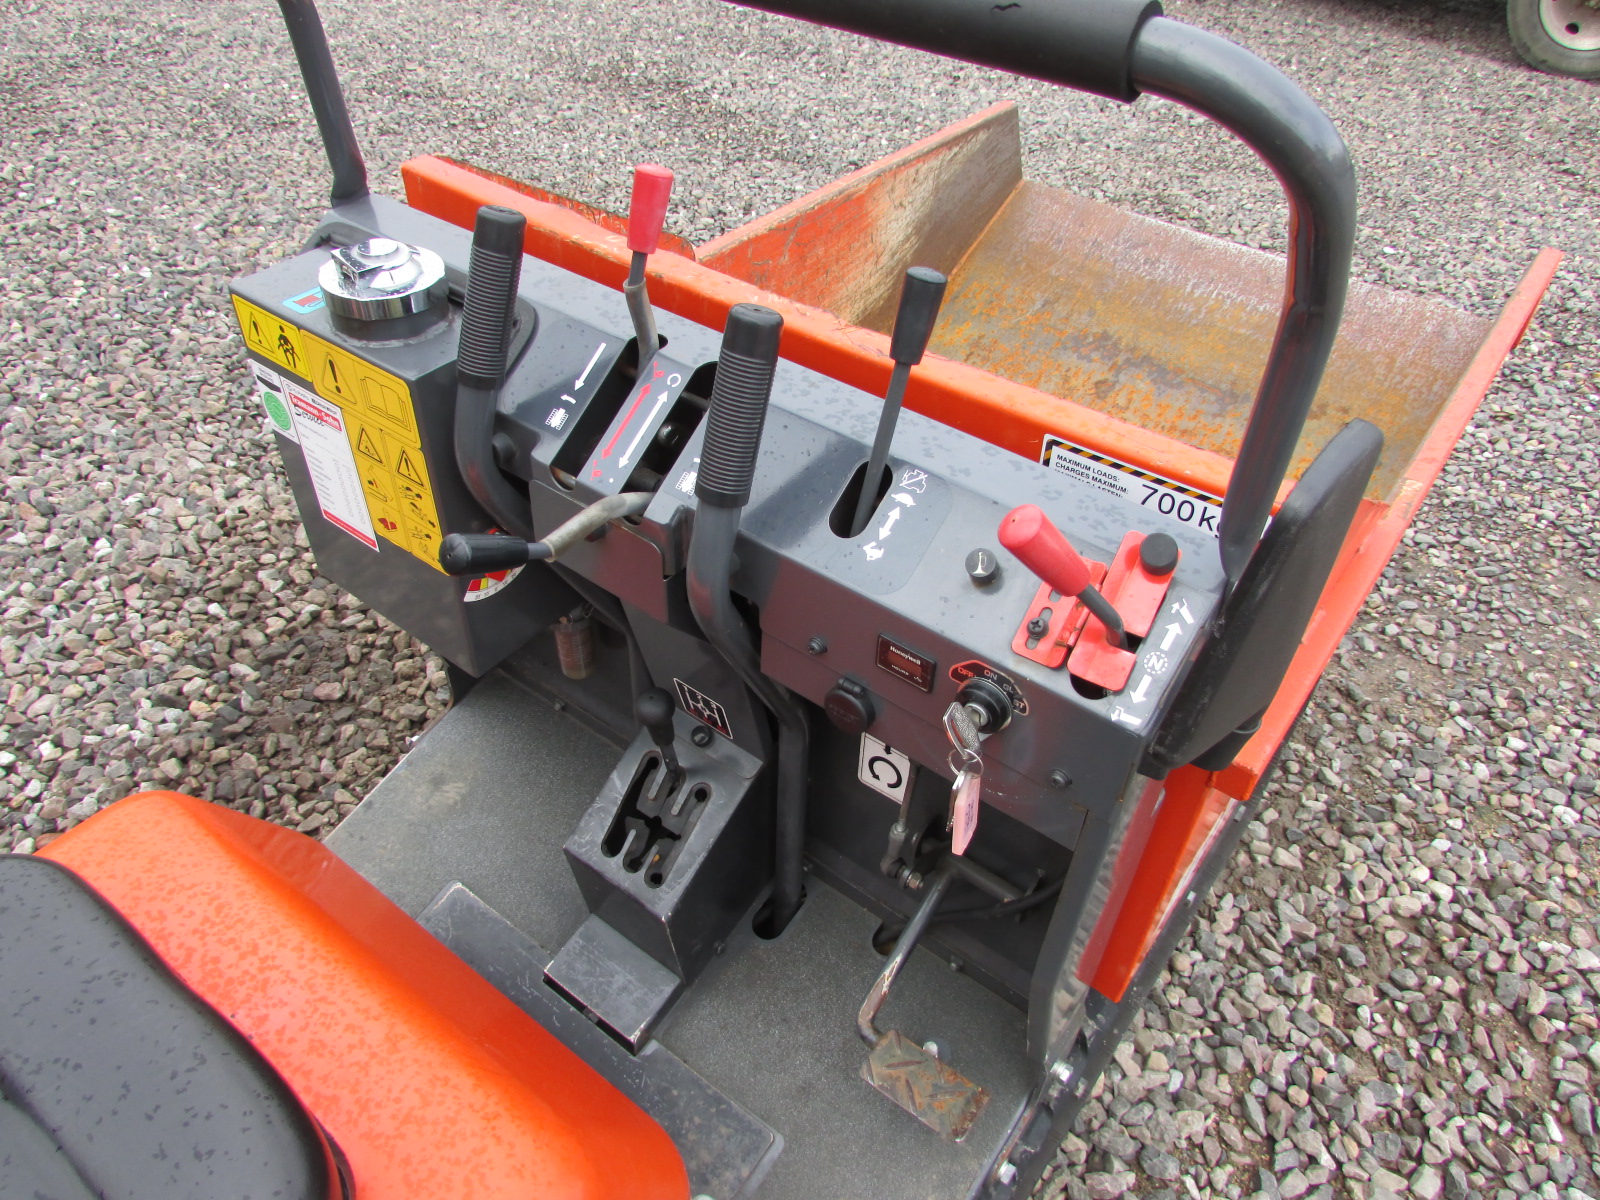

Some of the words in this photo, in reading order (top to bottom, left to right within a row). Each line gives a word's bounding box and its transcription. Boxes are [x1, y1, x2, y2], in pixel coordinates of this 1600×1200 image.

[1055, 461, 1090, 479] CHARGES
[1091, 475, 1129, 494] MAXIMUM:
[1056, 454, 1091, 471] MAXIMUM
[1092, 467, 1120, 482] LOADS:
[1140, 483, 1195, 522] 700
[1197, 506, 1220, 539] k
[890, 645, 921, 666] Honeywell
[1147, 654, 1164, 671] N
[957, 666, 975, 678] OFF
[983, 669, 998, 681] ON
[1002, 683, 1014, 694] GL
